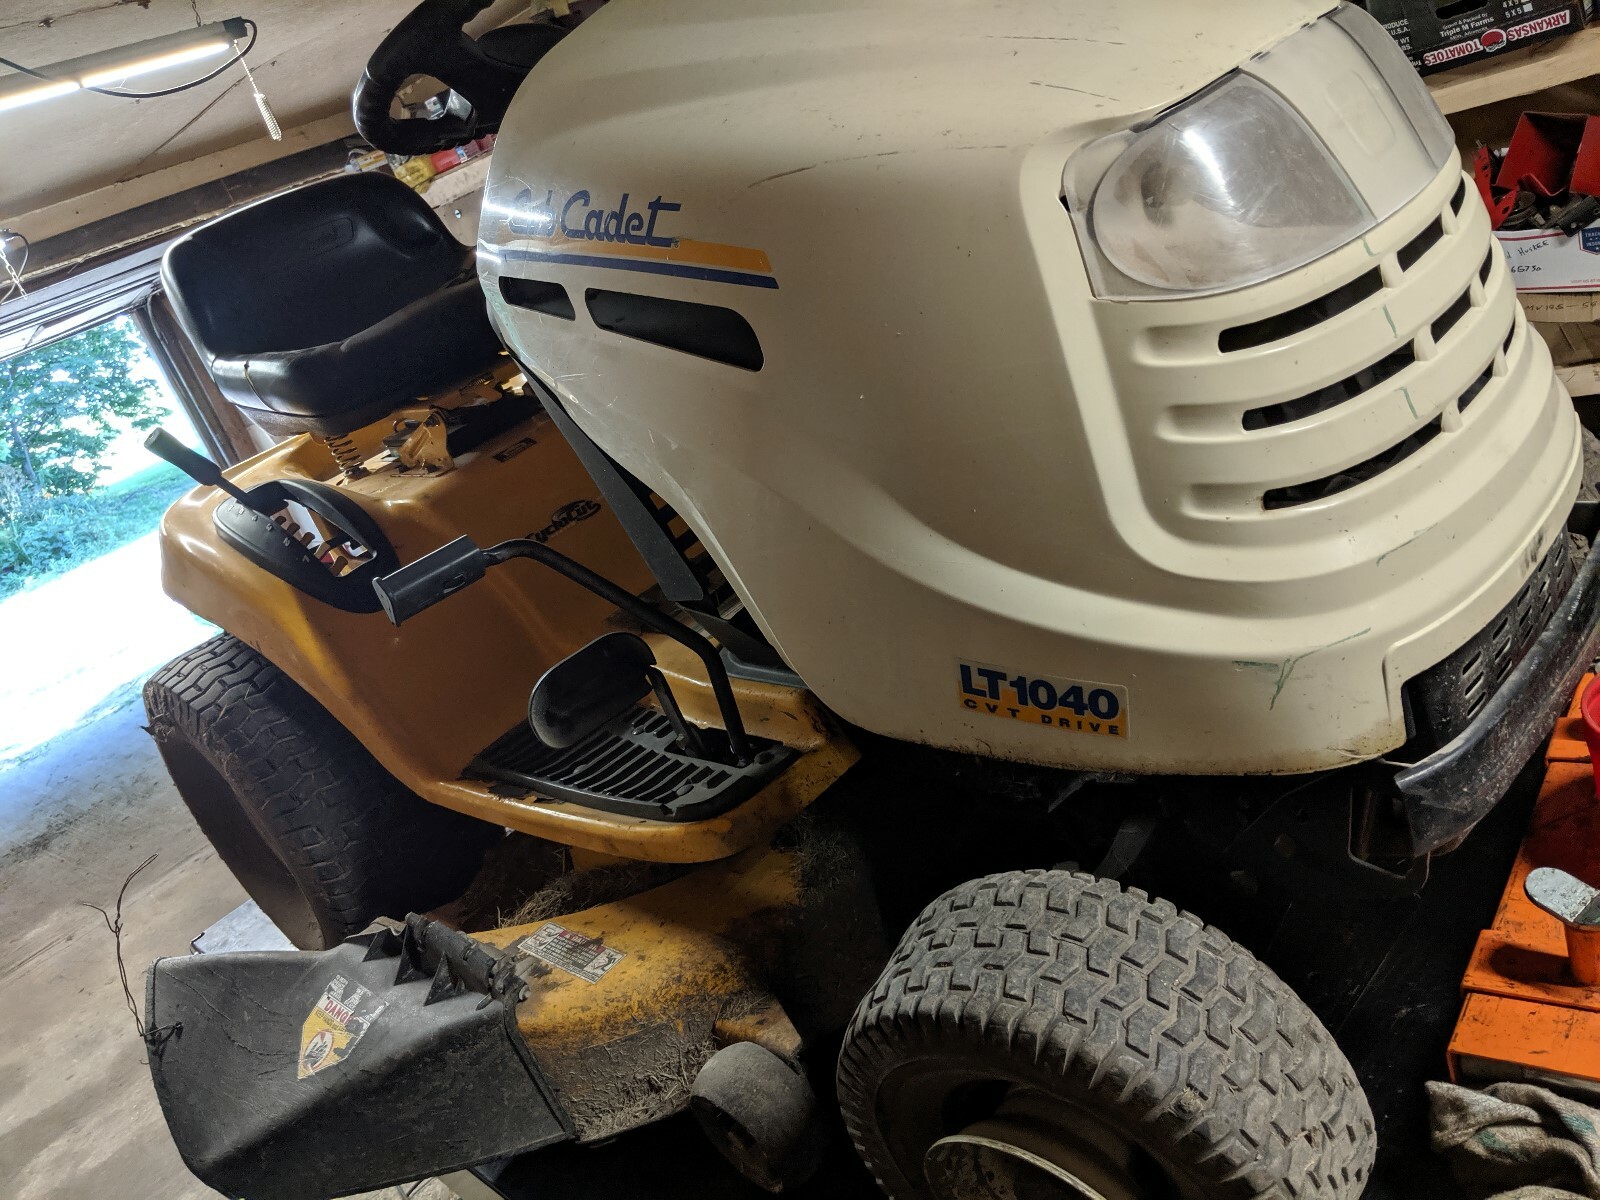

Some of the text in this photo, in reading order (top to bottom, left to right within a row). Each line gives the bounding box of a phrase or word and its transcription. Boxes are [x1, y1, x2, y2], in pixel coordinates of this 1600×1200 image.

[1383, 18, 1409, 30] RODUCE
[1440, 27, 1461, 38] Triple
[1470, 17, 1495, 29] Farms
[1506, 12, 1568, 40] ARKANSAS
[1424, 39, 1481, 66] TOMATOES
[560, 189, 681, 247] Cadet
[959, 663, 1120, 720] LT1040
[963, 698, 1119, 735] CVT DRIVE
[323, 999, 354, 1026] DANG
